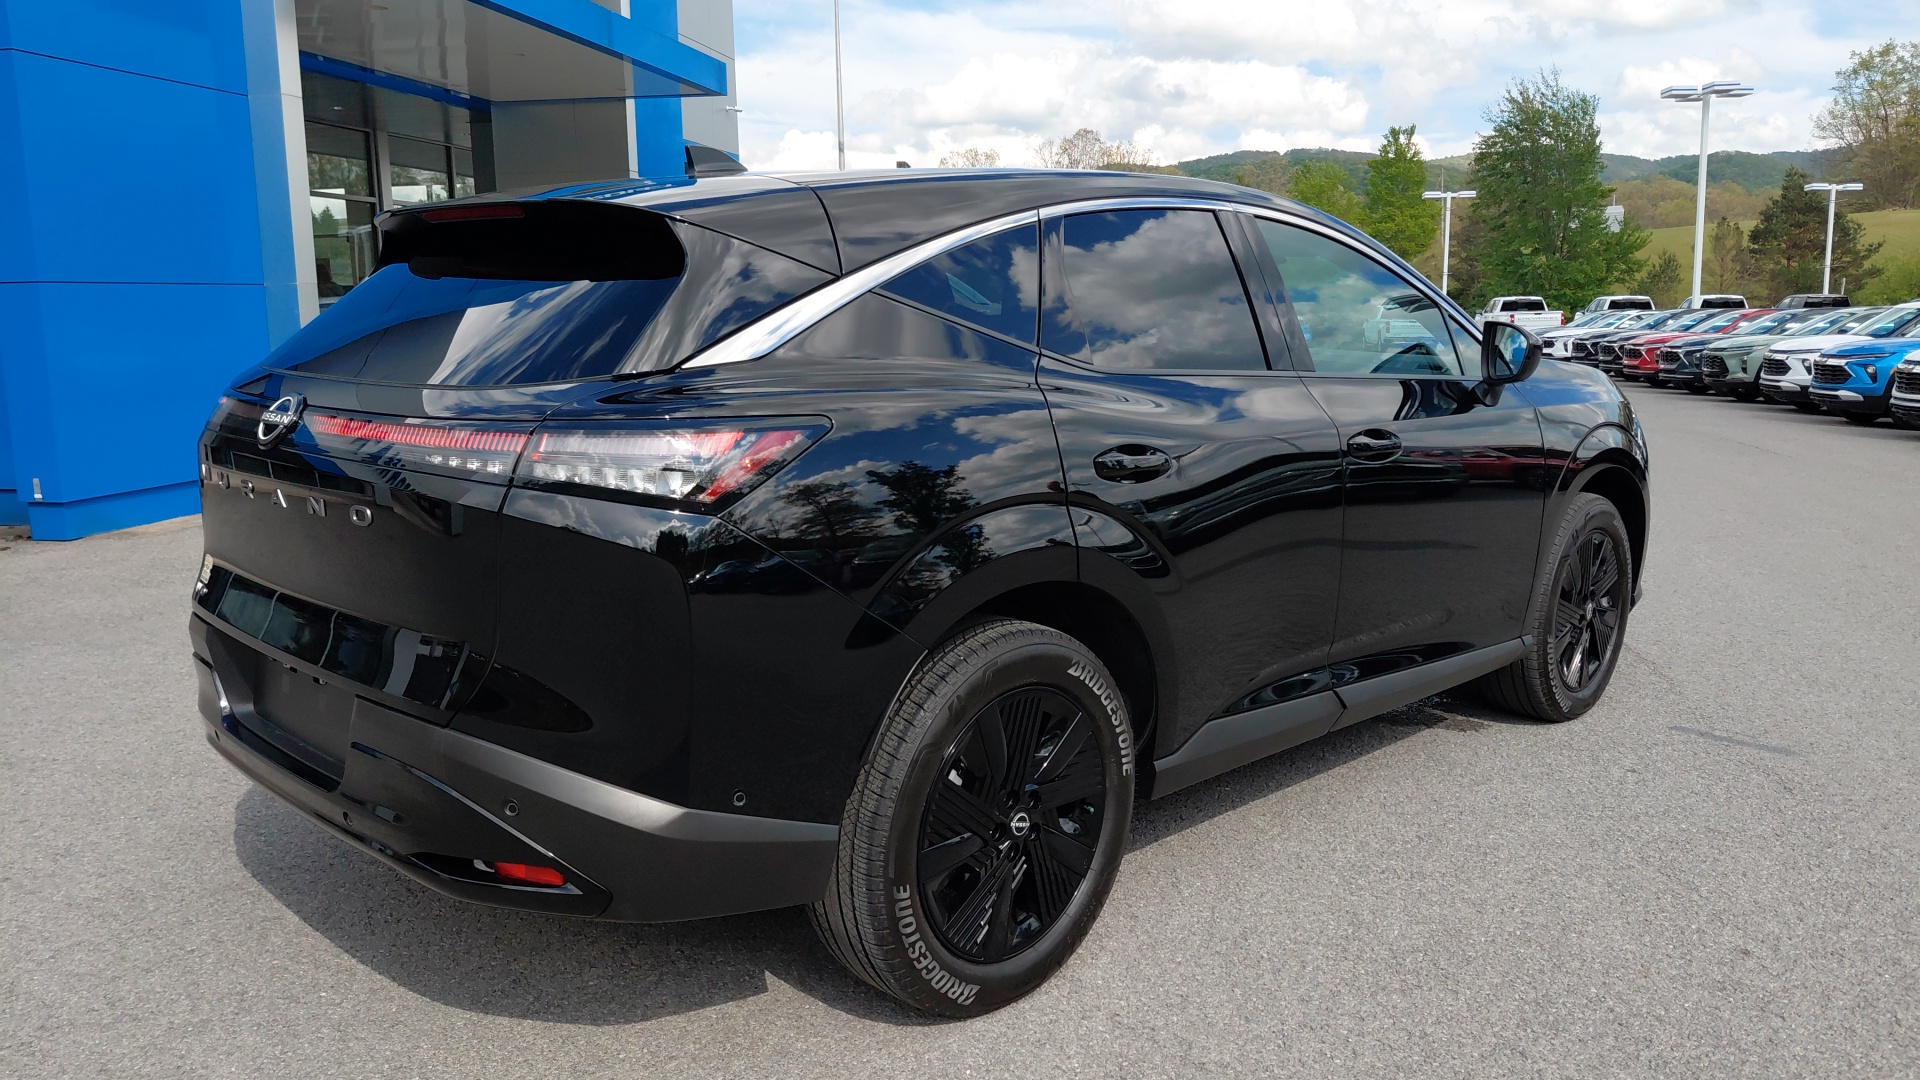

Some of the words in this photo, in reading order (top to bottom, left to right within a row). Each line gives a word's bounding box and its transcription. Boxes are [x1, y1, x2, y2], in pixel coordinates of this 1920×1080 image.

[262, 411, 291, 424] ISSAN
[1067, 656, 1134, 777] BRIDGESTONE
[893, 883, 982, 1007] BRIDGESTONE
